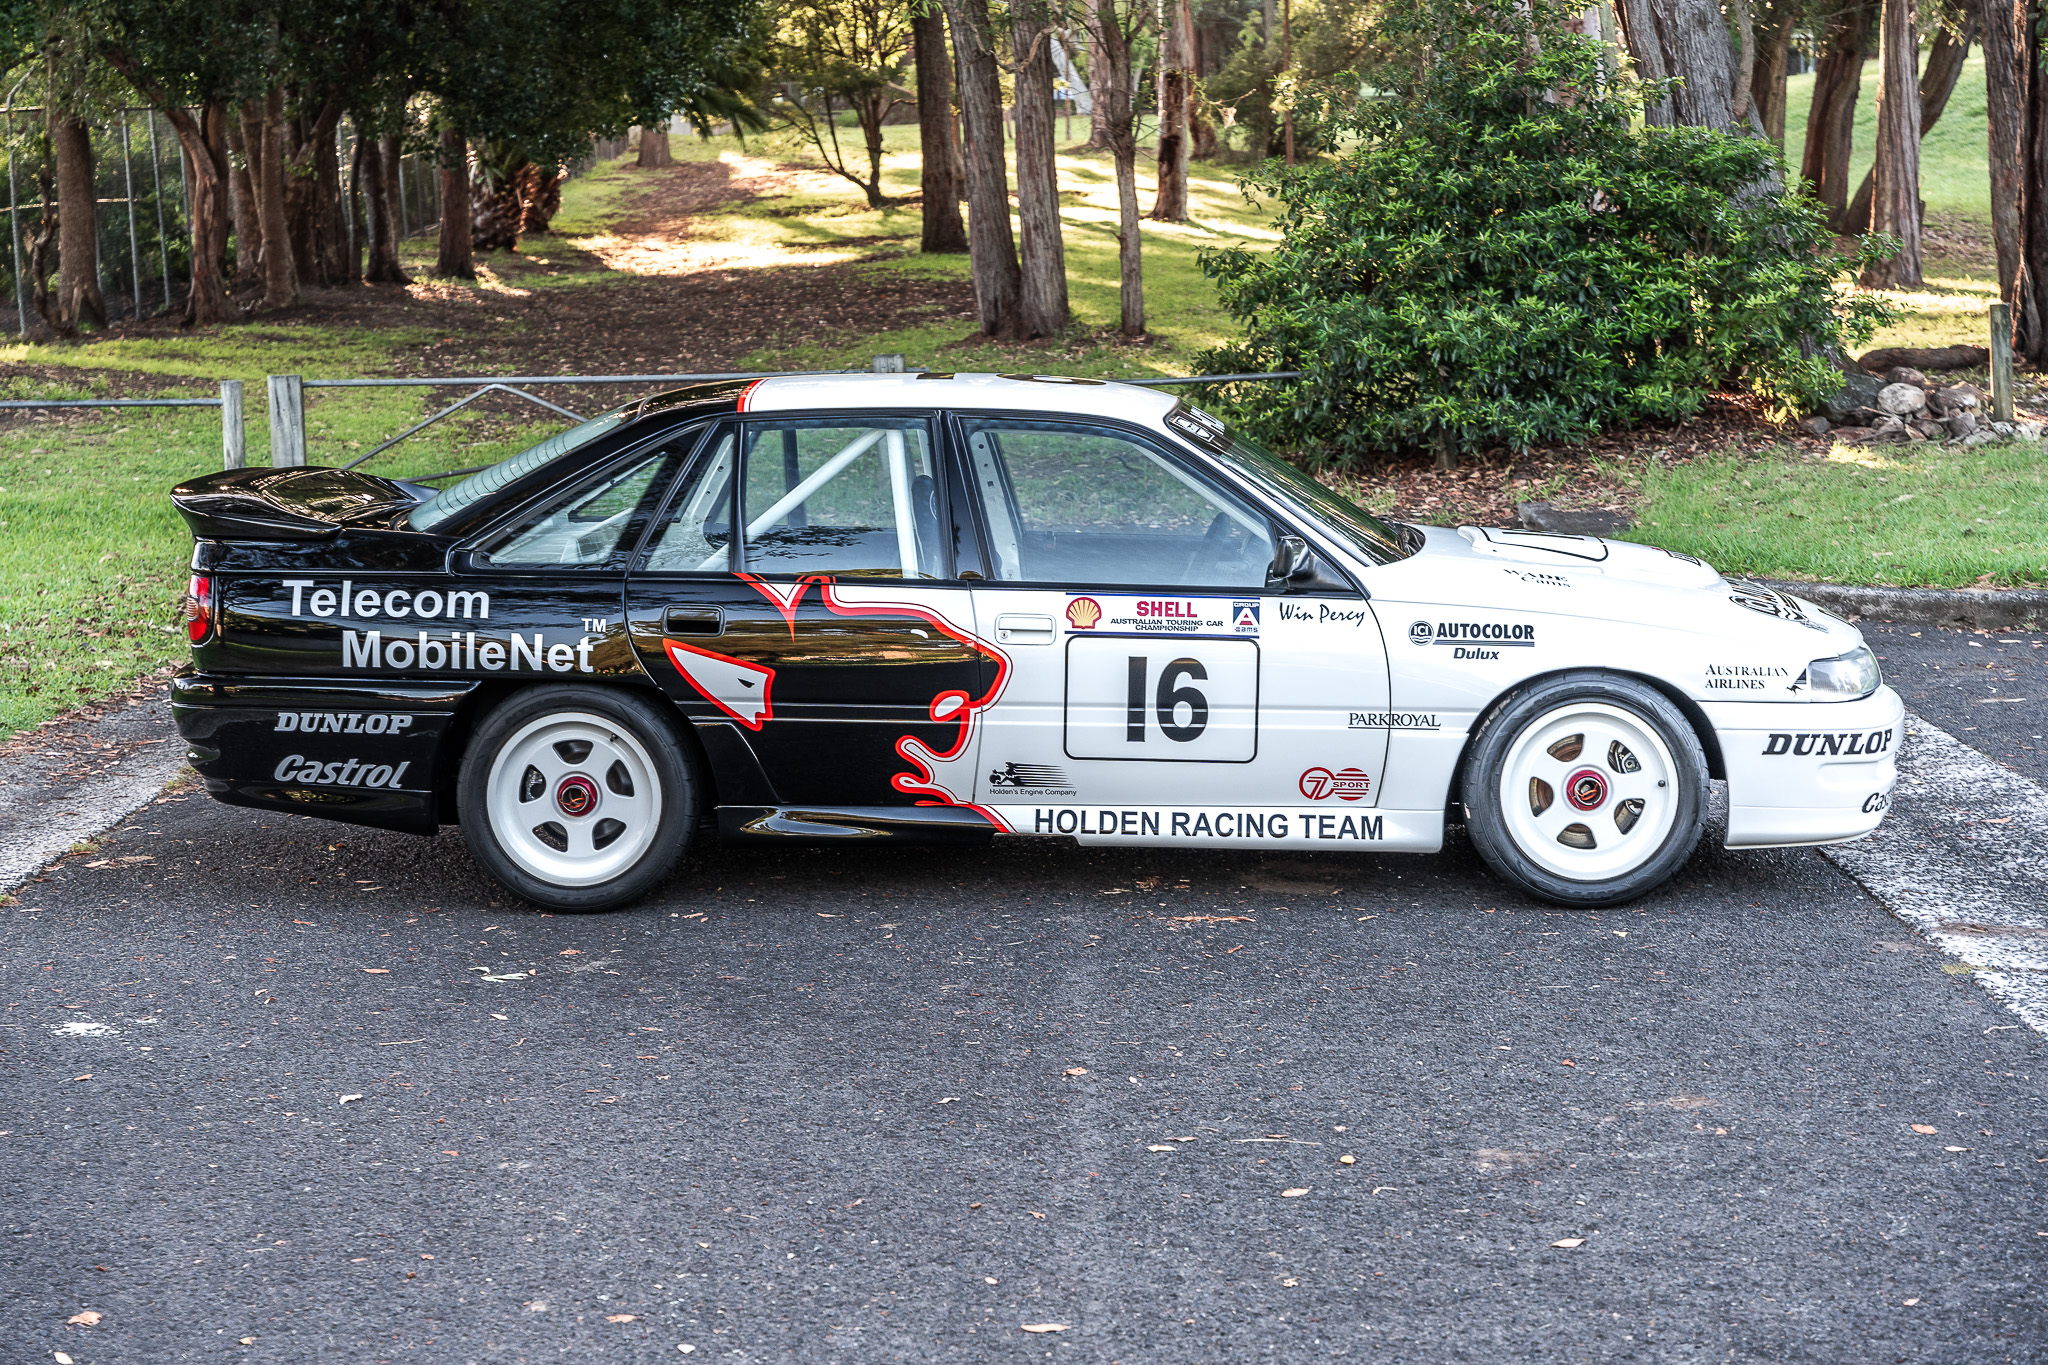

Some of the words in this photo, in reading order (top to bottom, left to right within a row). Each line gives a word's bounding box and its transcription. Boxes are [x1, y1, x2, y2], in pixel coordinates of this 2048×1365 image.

[283, 580, 489, 619] Telecom
[1137, 600, 1197, 618] SHELL
[1280, 602, 1313, 621] Win
[1319, 604, 1365, 627] Percy
[581, 618, 607, 633] TM
[1110, 618, 1162, 626] AUSTRALIAN
[1414, 625, 1429, 635] ICI
[1436, 622, 1535, 640] AUTOCOLOR
[342, 630, 594, 673] MobileNet
[1453, 647, 1500, 660] Dulux
[1705, 663, 1789, 677] AUSTRALIAN
[1705, 678, 1765, 689] AIRLINES
[1126, 656, 1209, 742] 16
[274, 712, 412, 735] DUNLOP
[1349, 712, 1441, 727] PARKROYAL
[1761, 728, 1893, 756] DUNLOP
[273, 754, 410, 789] Castrol
[1332, 781, 1370, 789] SPORT
[1034, 808, 1160, 836] HOLDEN
[1171, 812, 1289, 839] RACING
[1299, 814, 1383, 840] TEAM
